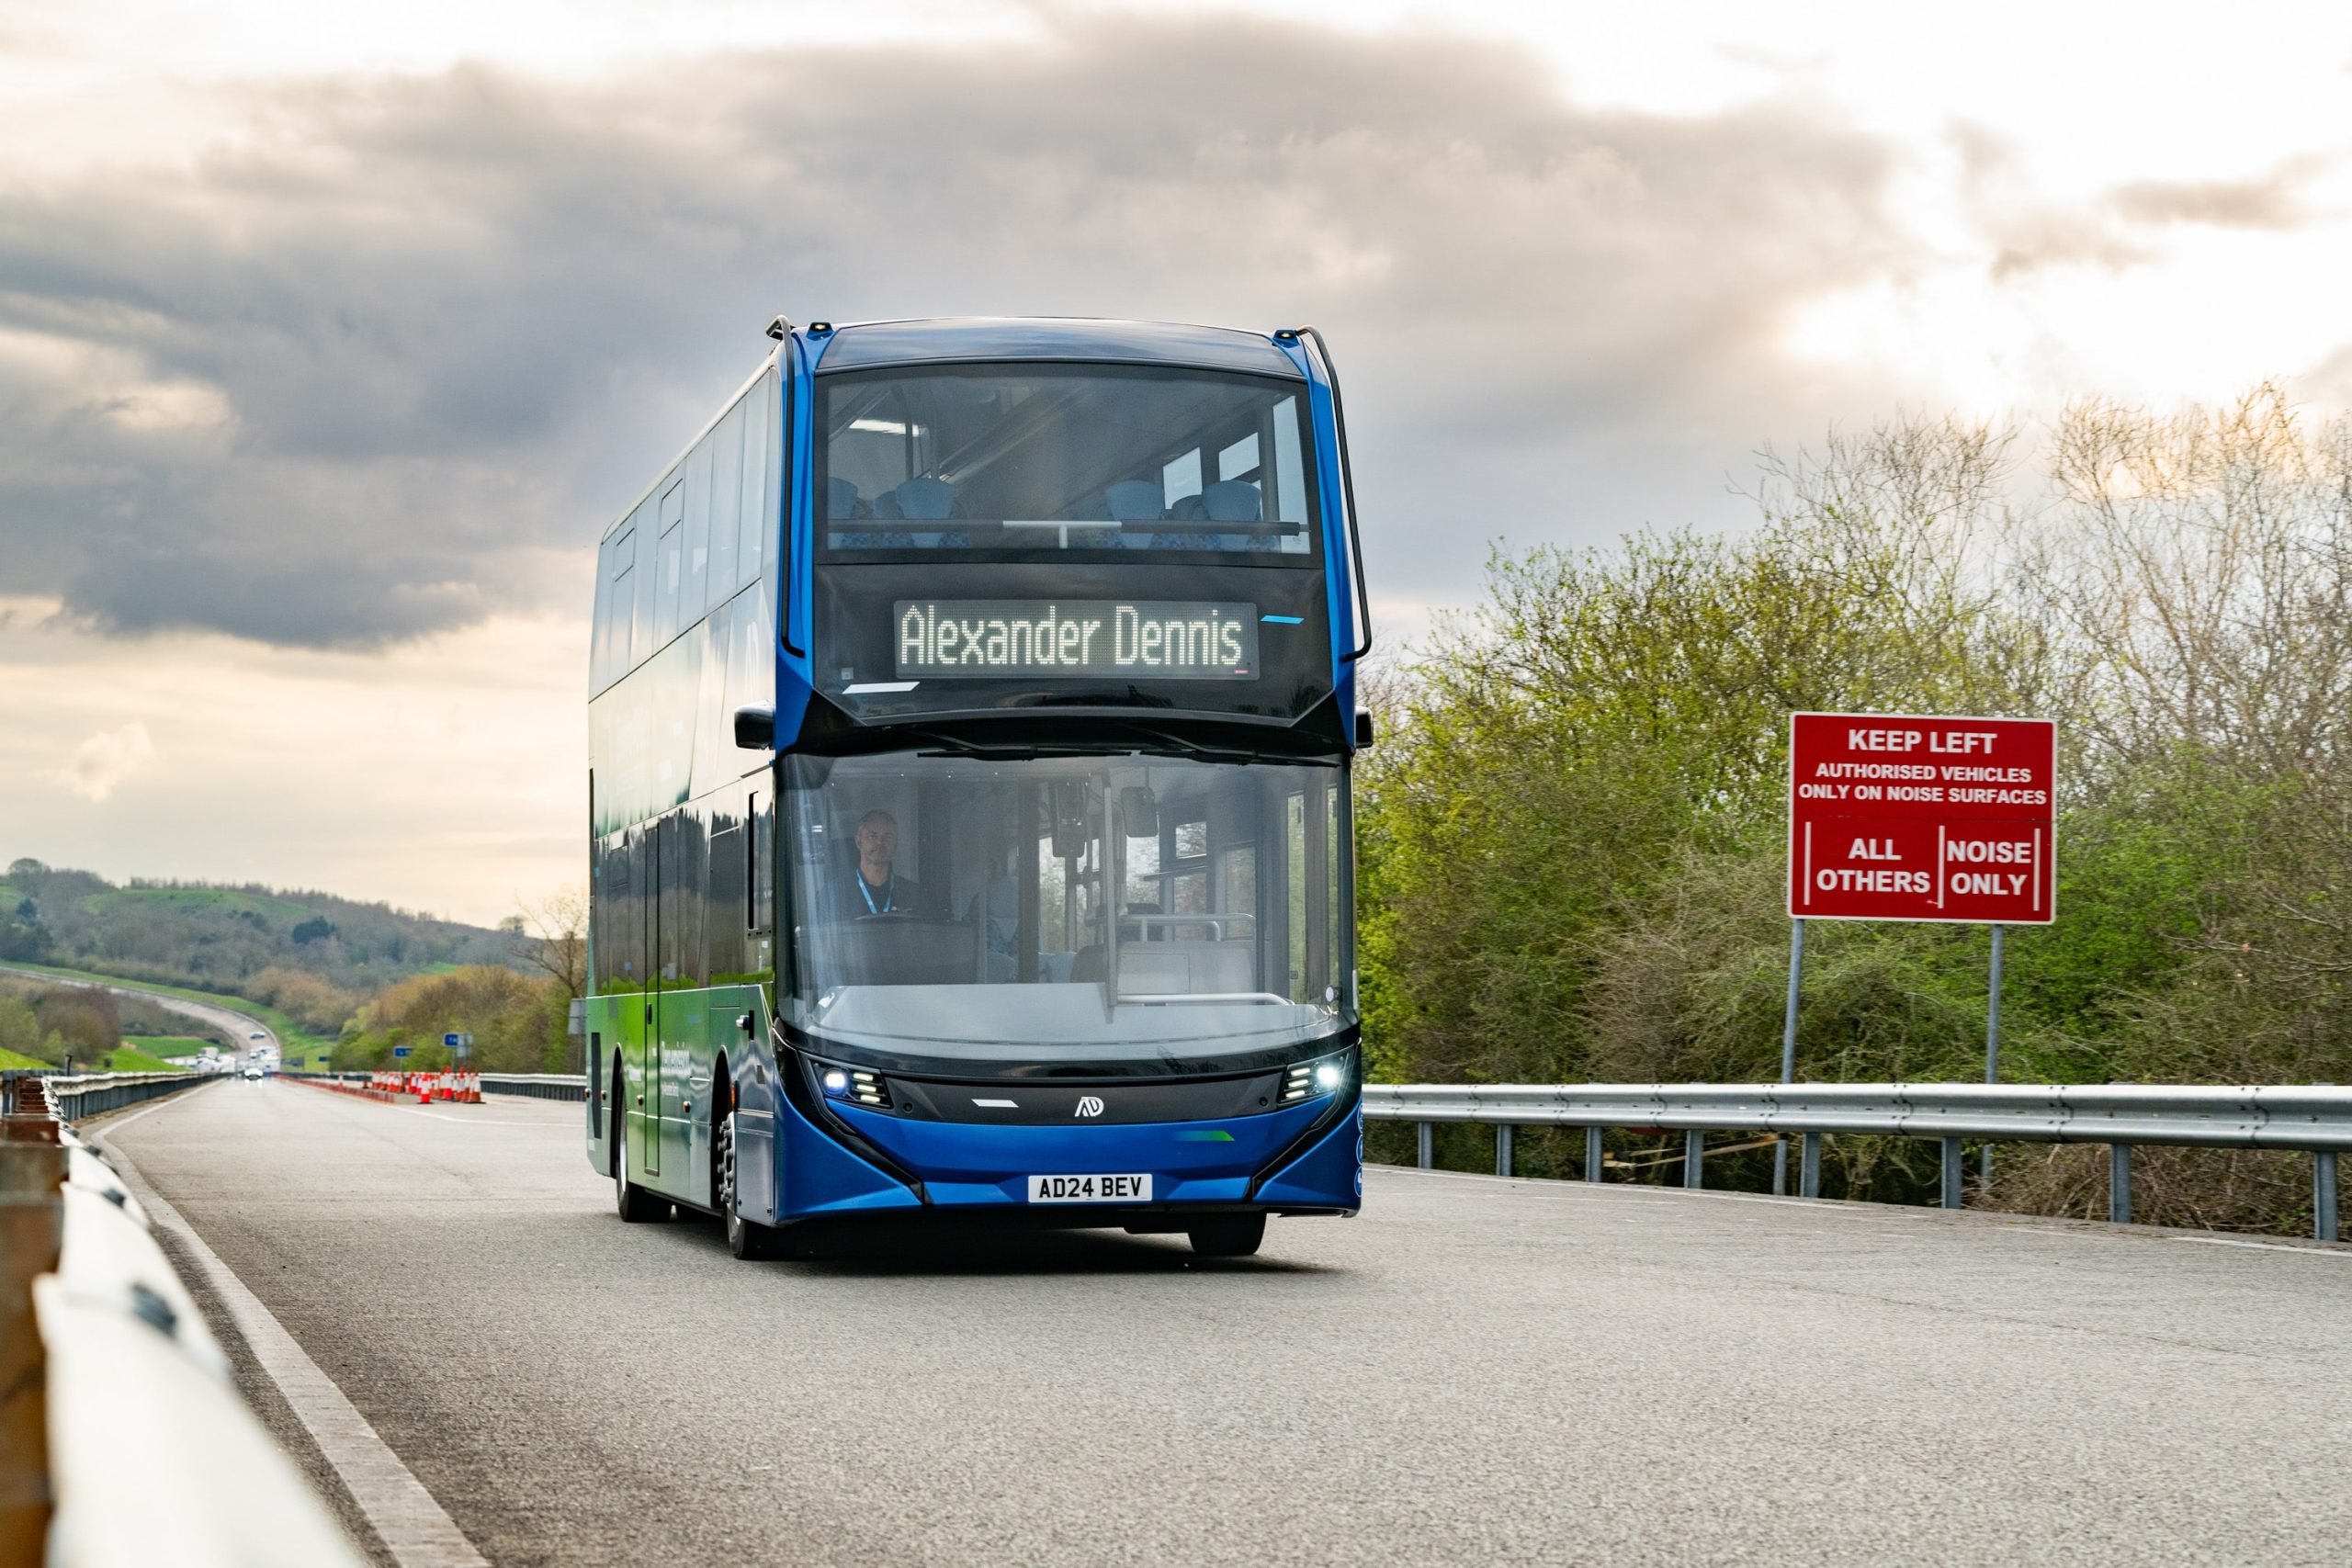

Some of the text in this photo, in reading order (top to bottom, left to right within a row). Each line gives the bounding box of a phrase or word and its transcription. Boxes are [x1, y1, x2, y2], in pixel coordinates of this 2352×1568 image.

[901, 605, 1241, 665] Alexander Dennis
[1849, 729, 1997, 753] KEEP LEFT
[1815, 763, 2031, 783] AUTHORISED VEHICLES
[1799, 784, 2046, 804] ONLY ON NOISE SURFACES
[1849, 839, 1901, 860] ALL
[1948, 840, 2030, 863] NOISE
[1817, 869, 1930, 893] OTHERS
[1951, 873, 2027, 895] ONLY
[1039, 1177, 1142, 1198] AD24 BEV
